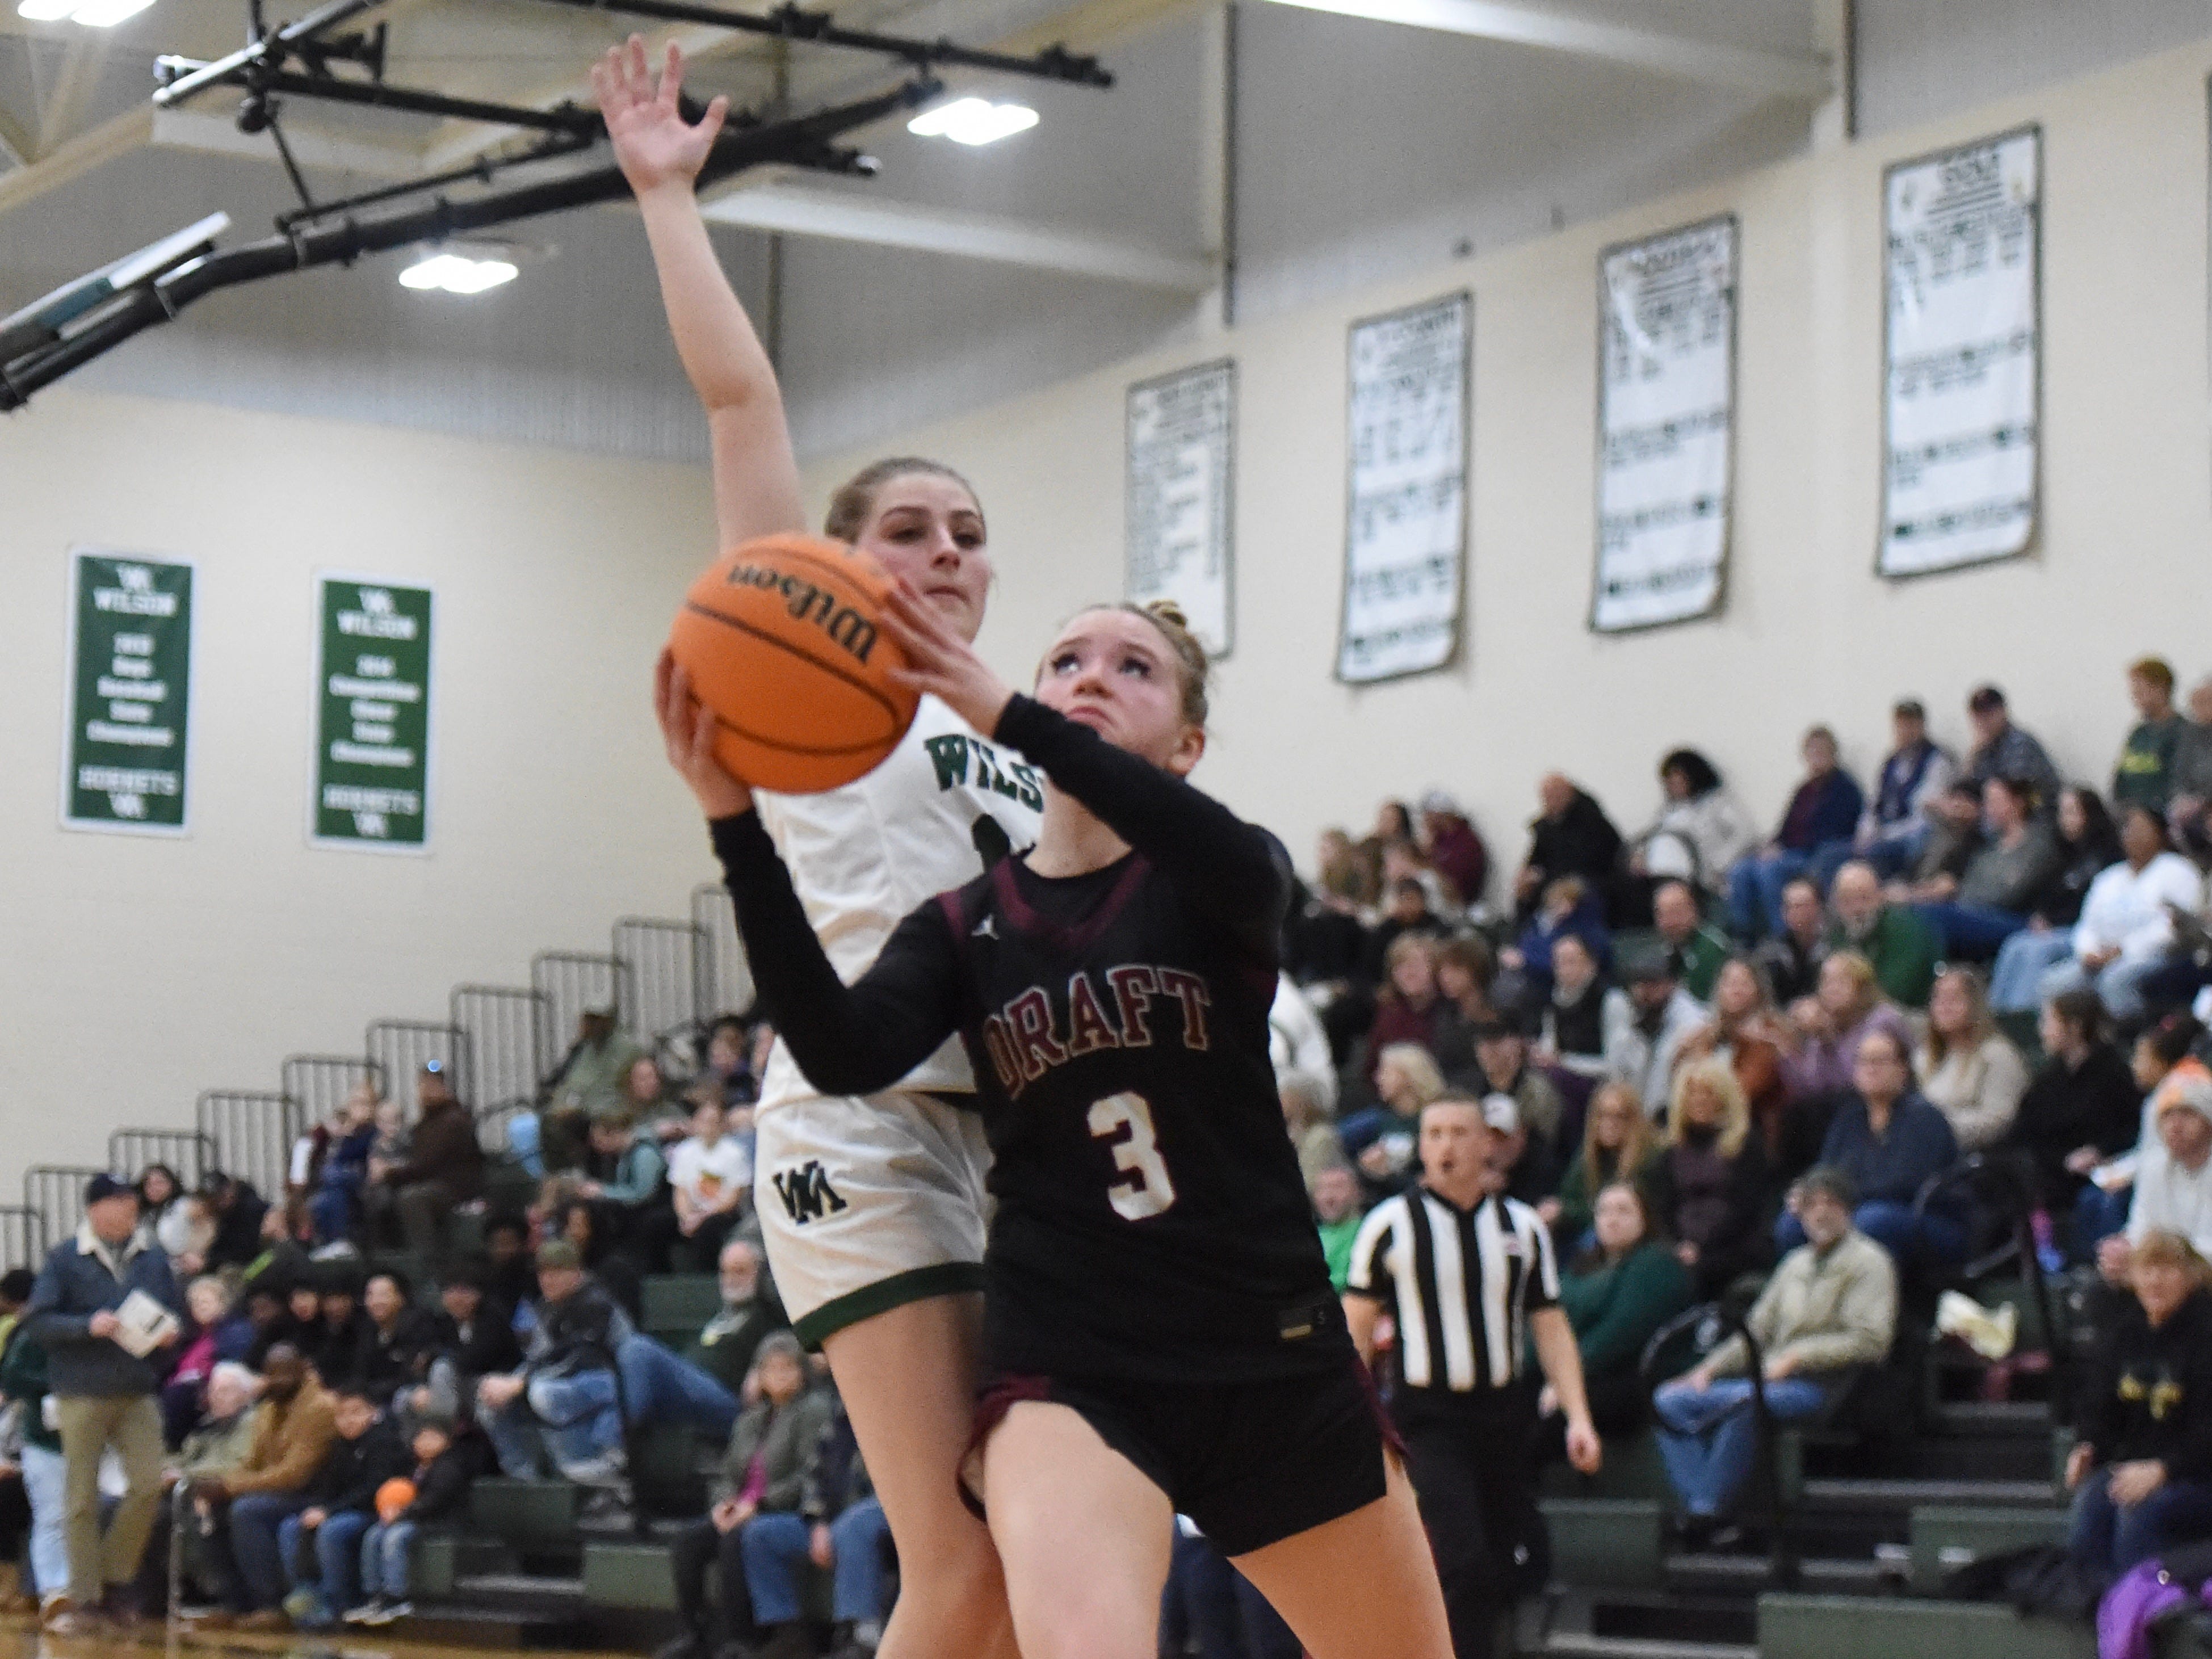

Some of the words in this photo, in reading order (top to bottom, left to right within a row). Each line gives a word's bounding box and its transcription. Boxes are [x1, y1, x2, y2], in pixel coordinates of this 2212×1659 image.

[93, 586, 177, 616] WILSON
[728, 564, 878, 665] Wilson
[983, 963, 1212, 1100] DRAFT
[1086, 1090, 1177, 1222] 3
